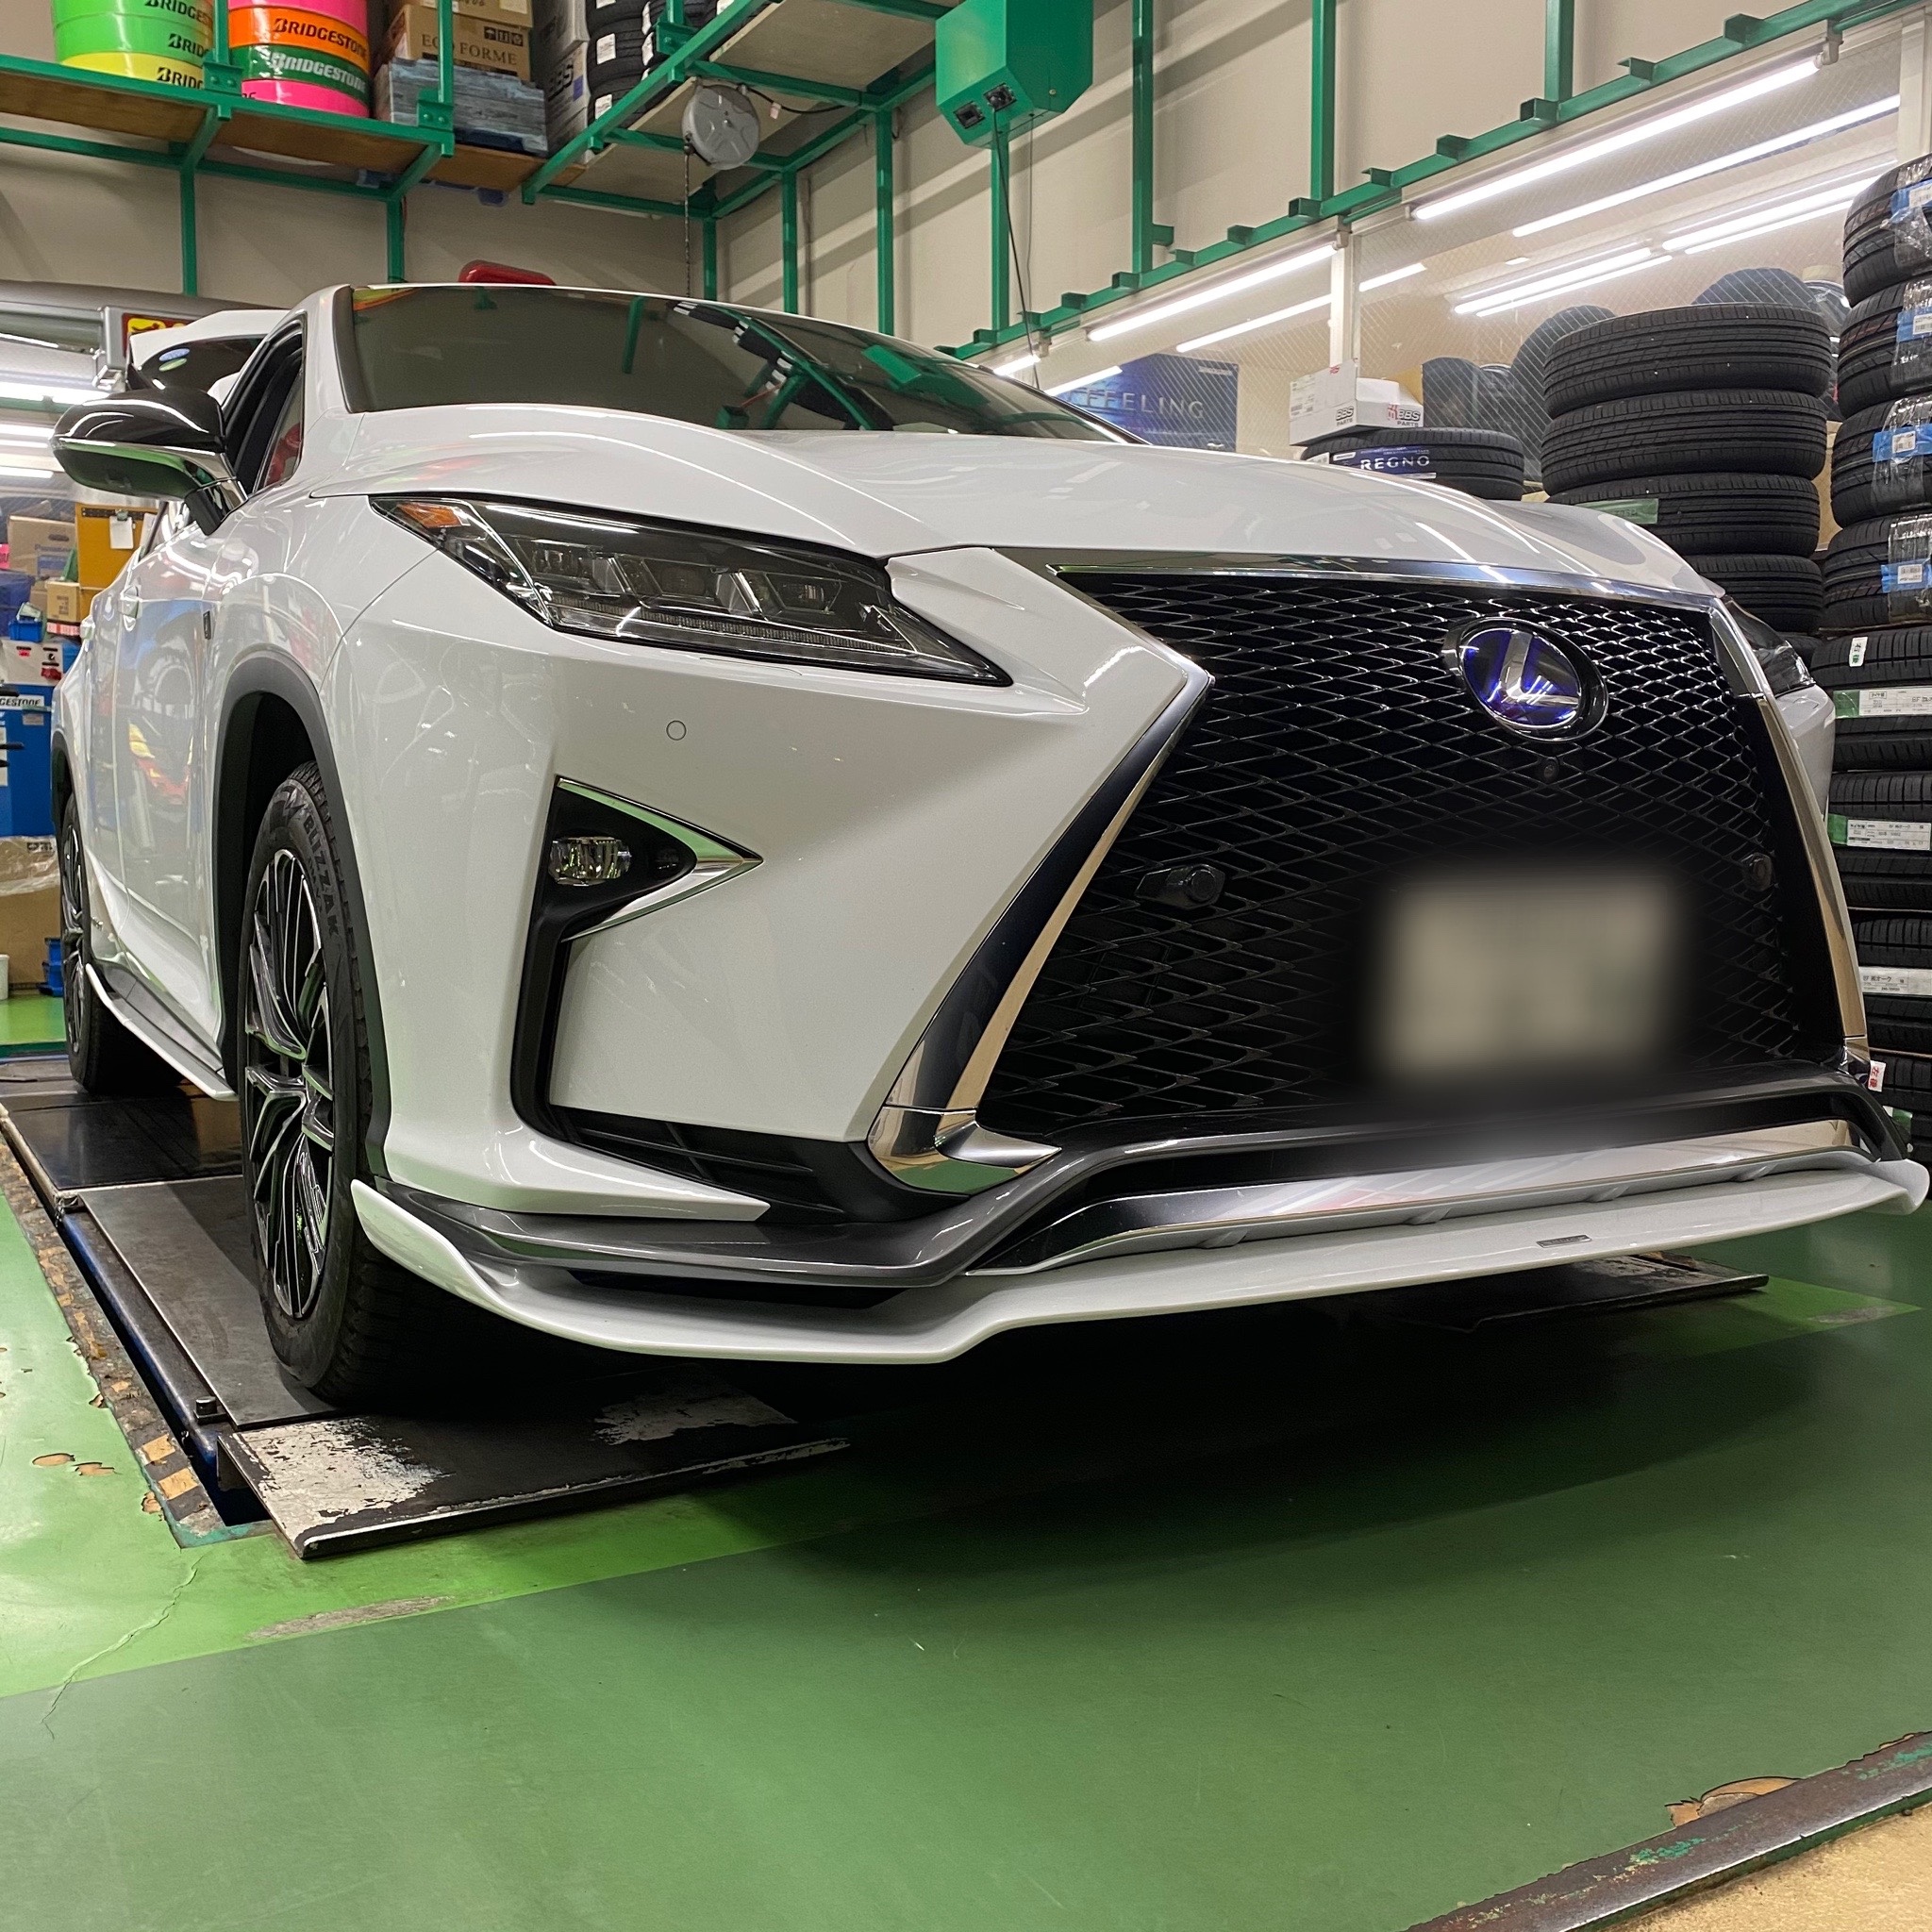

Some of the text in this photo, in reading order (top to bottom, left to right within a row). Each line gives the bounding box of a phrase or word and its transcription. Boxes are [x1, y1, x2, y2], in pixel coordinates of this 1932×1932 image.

[459, 42, 518, 66] FORME
[1398, 408, 1421, 422] BBS
[1360, 455, 1430, 471] REGNO
[303, 815, 340, 935] BLIZZAK
